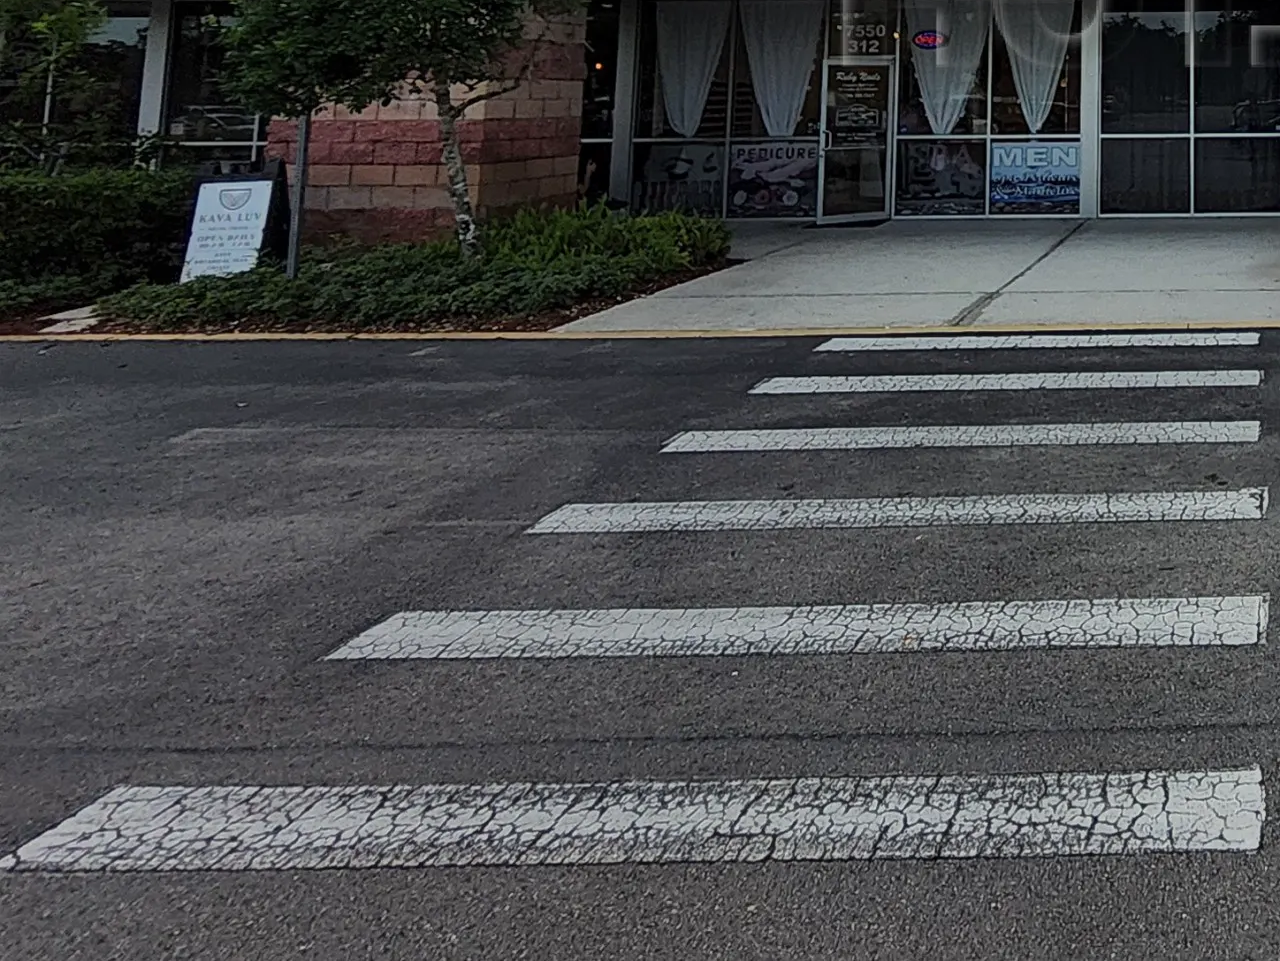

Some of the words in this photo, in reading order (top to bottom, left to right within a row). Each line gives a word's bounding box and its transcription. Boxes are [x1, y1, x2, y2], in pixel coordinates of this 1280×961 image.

[845, 24, 886, 39] 7550
[848, 40, 880, 54] 312
[736, 147, 817, 160] PEDICURE
[993, 146, 1078, 168] MEN
[199, 214, 232, 224] KAVA
[237, 212, 262, 222] LUV
